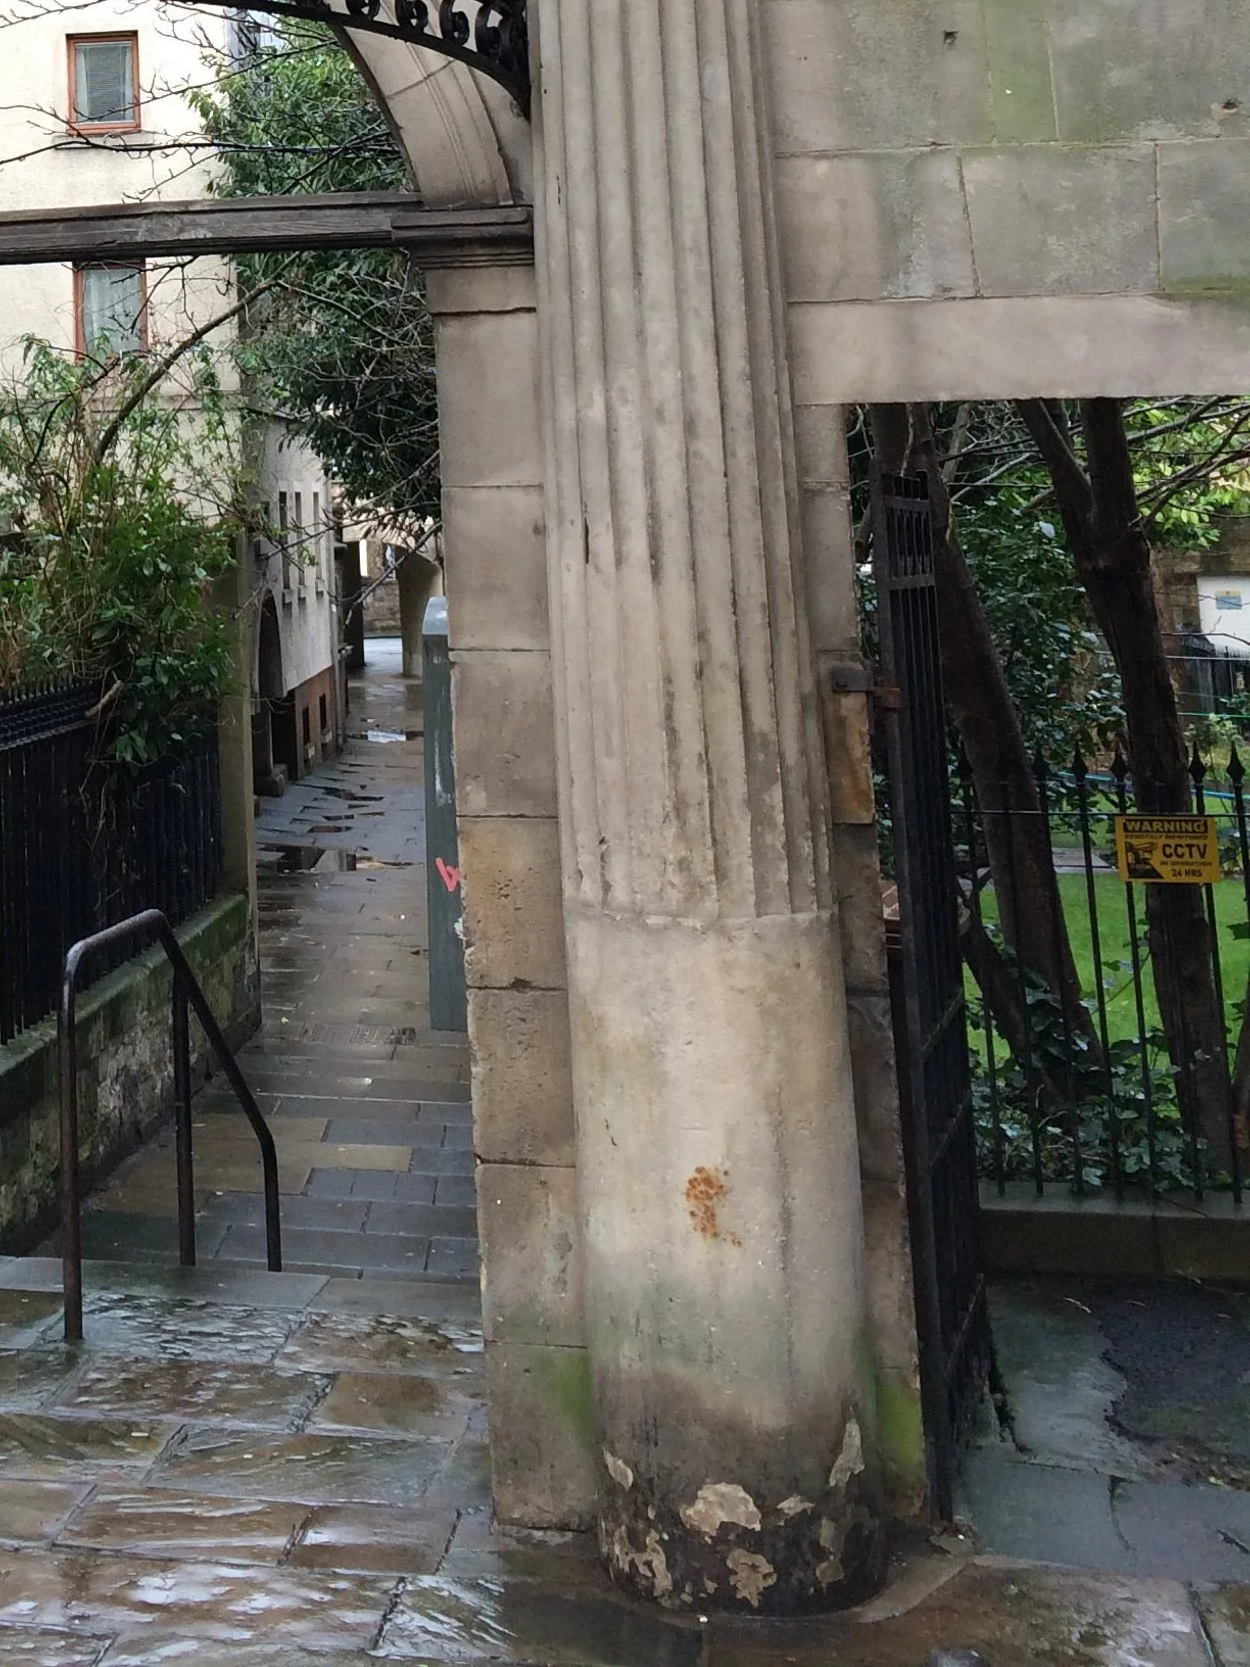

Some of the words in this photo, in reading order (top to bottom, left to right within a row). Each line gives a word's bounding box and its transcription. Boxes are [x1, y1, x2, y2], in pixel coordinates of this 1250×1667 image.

[1126, 820, 1205, 832] WARNING
[1162, 843, 1208, 859] CCTV
[1171, 868, 1182, 878] 24
[1185, 868, 1203, 877] HRS
